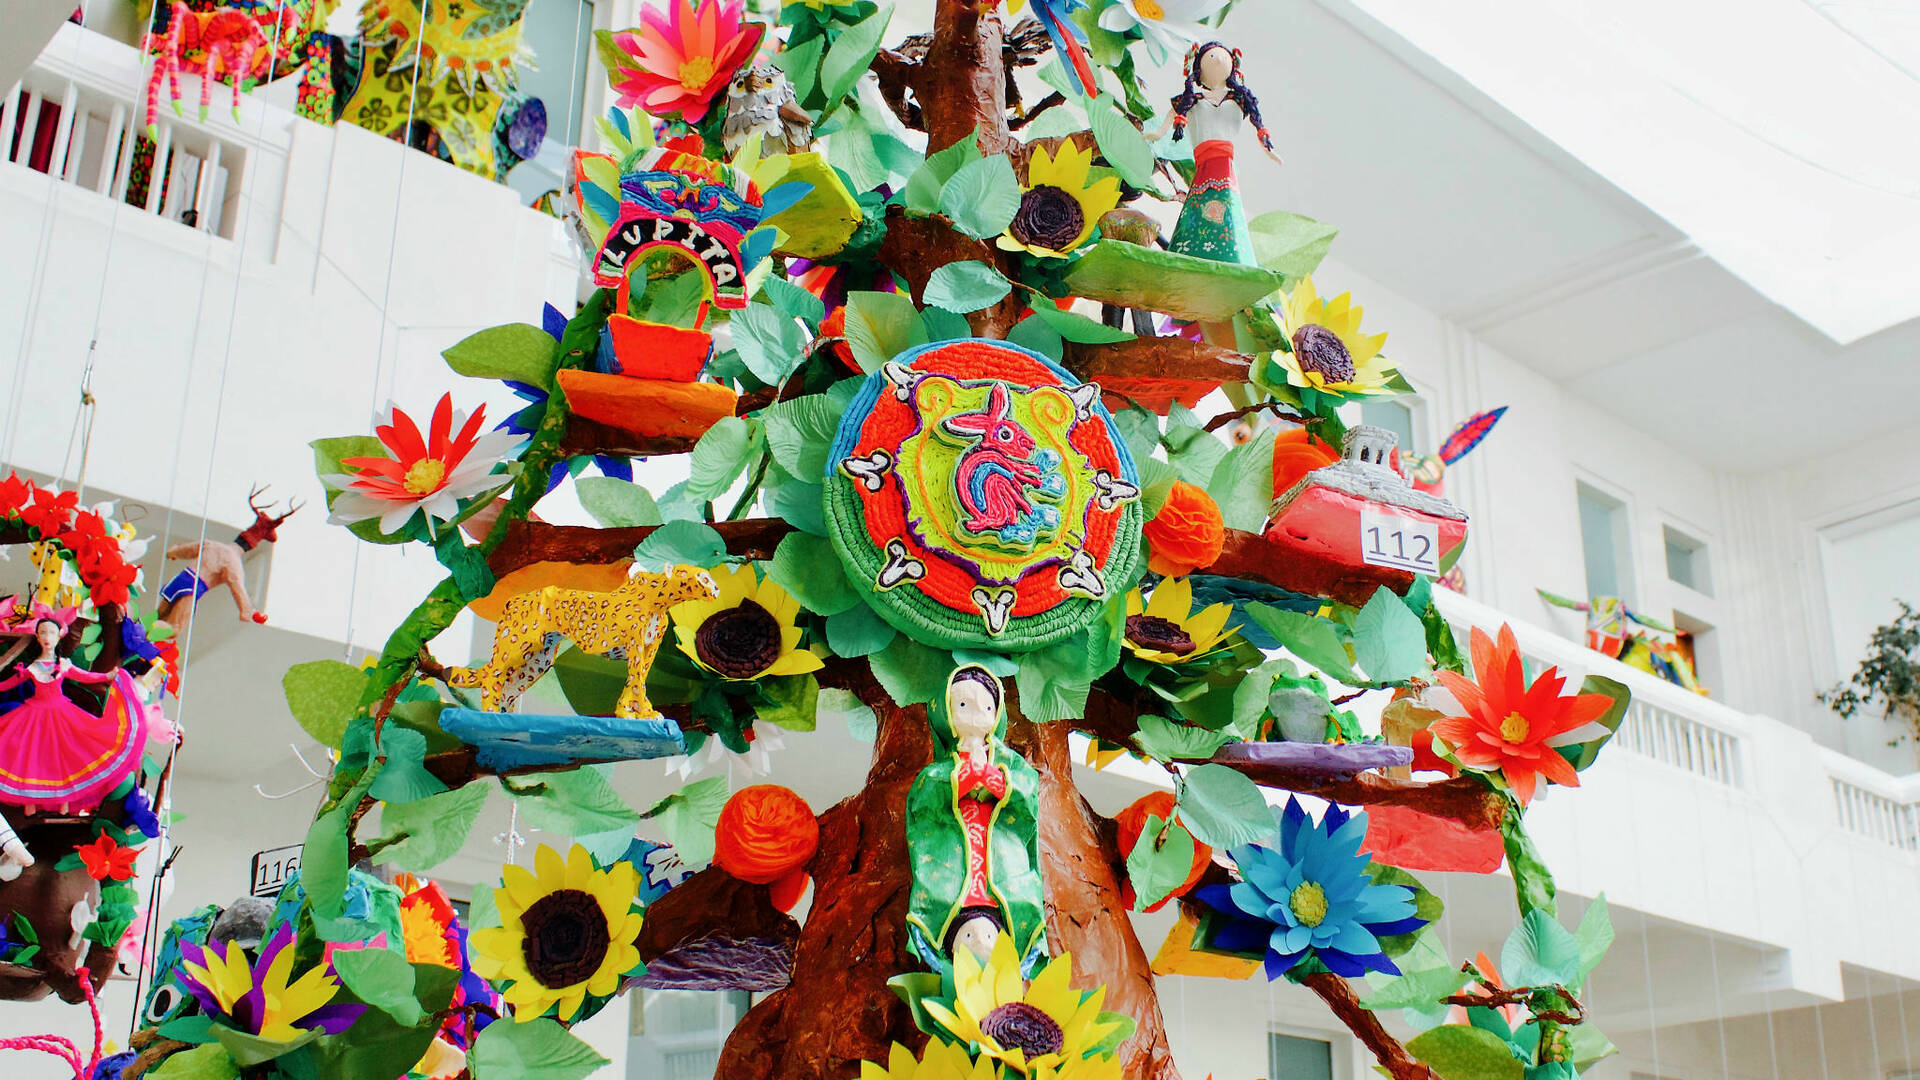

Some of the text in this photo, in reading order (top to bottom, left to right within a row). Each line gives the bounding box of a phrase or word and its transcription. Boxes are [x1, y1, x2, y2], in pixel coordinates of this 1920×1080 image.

[603, 218, 736, 284] LUPITA
[1367, 526, 1433, 565] 112
[258, 857, 298, 886] 116
